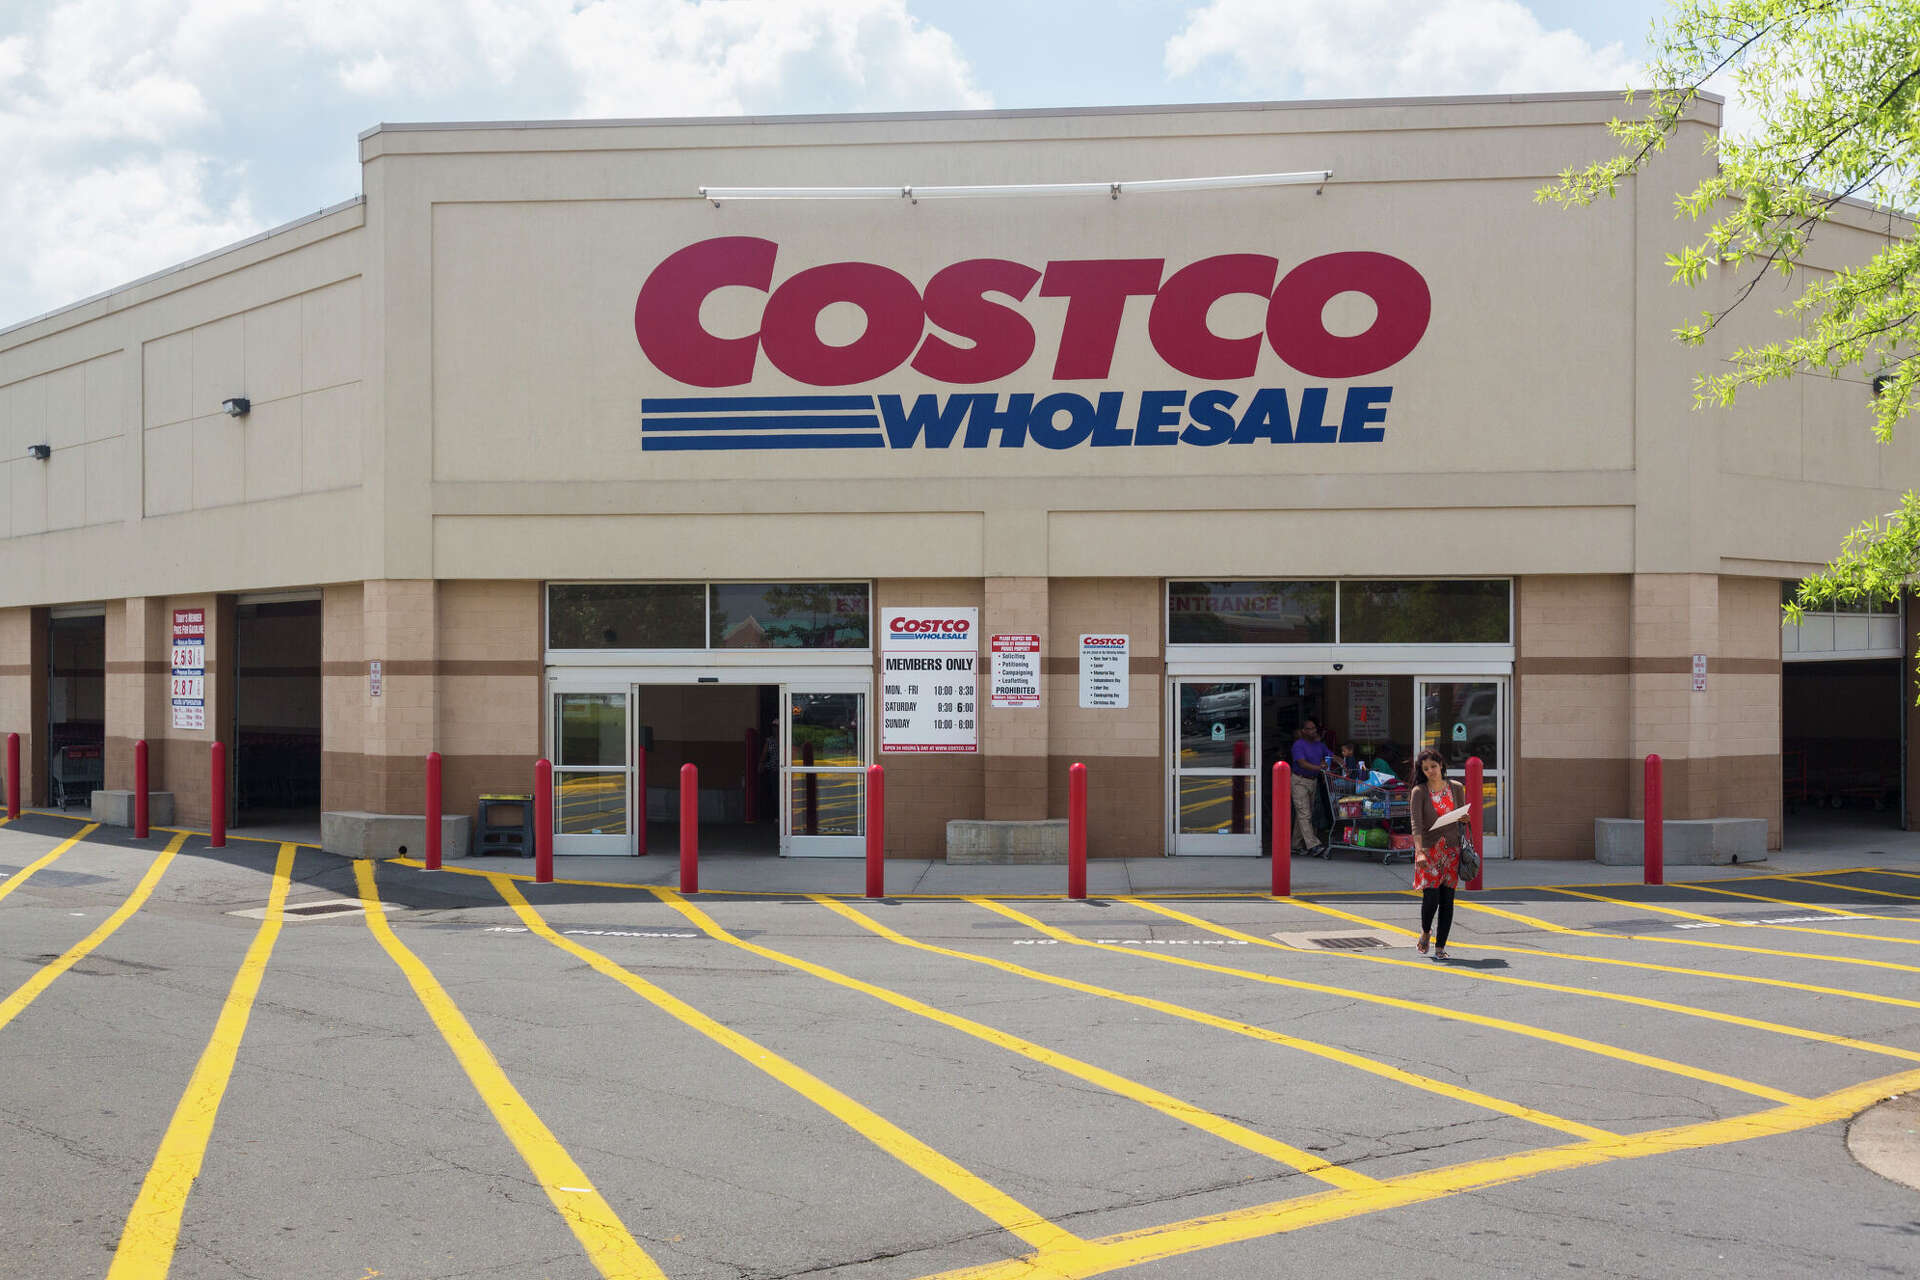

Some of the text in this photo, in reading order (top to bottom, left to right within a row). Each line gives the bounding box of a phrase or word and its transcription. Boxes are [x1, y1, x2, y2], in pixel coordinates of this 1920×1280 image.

[634, 236, 1431, 388] COSTCO
[876, 386, 1393, 449] WHOLESALE
[890, 616, 970, 632] COSTCO
[1083, 637, 1125, 645] COSTCO
[886, 658, 974, 671] MEMBERS ONLY
[908, 685, 918, 695] FRI
[934, 685, 953, 696] 10:00
[958, 685, 974, 696] 8:30
[885, 702, 917, 712] SATURDAY
[957, 702, 974, 713] 6:00
[885, 718, 910, 729] SUNDAY
[934, 719, 953, 730] 10:00
